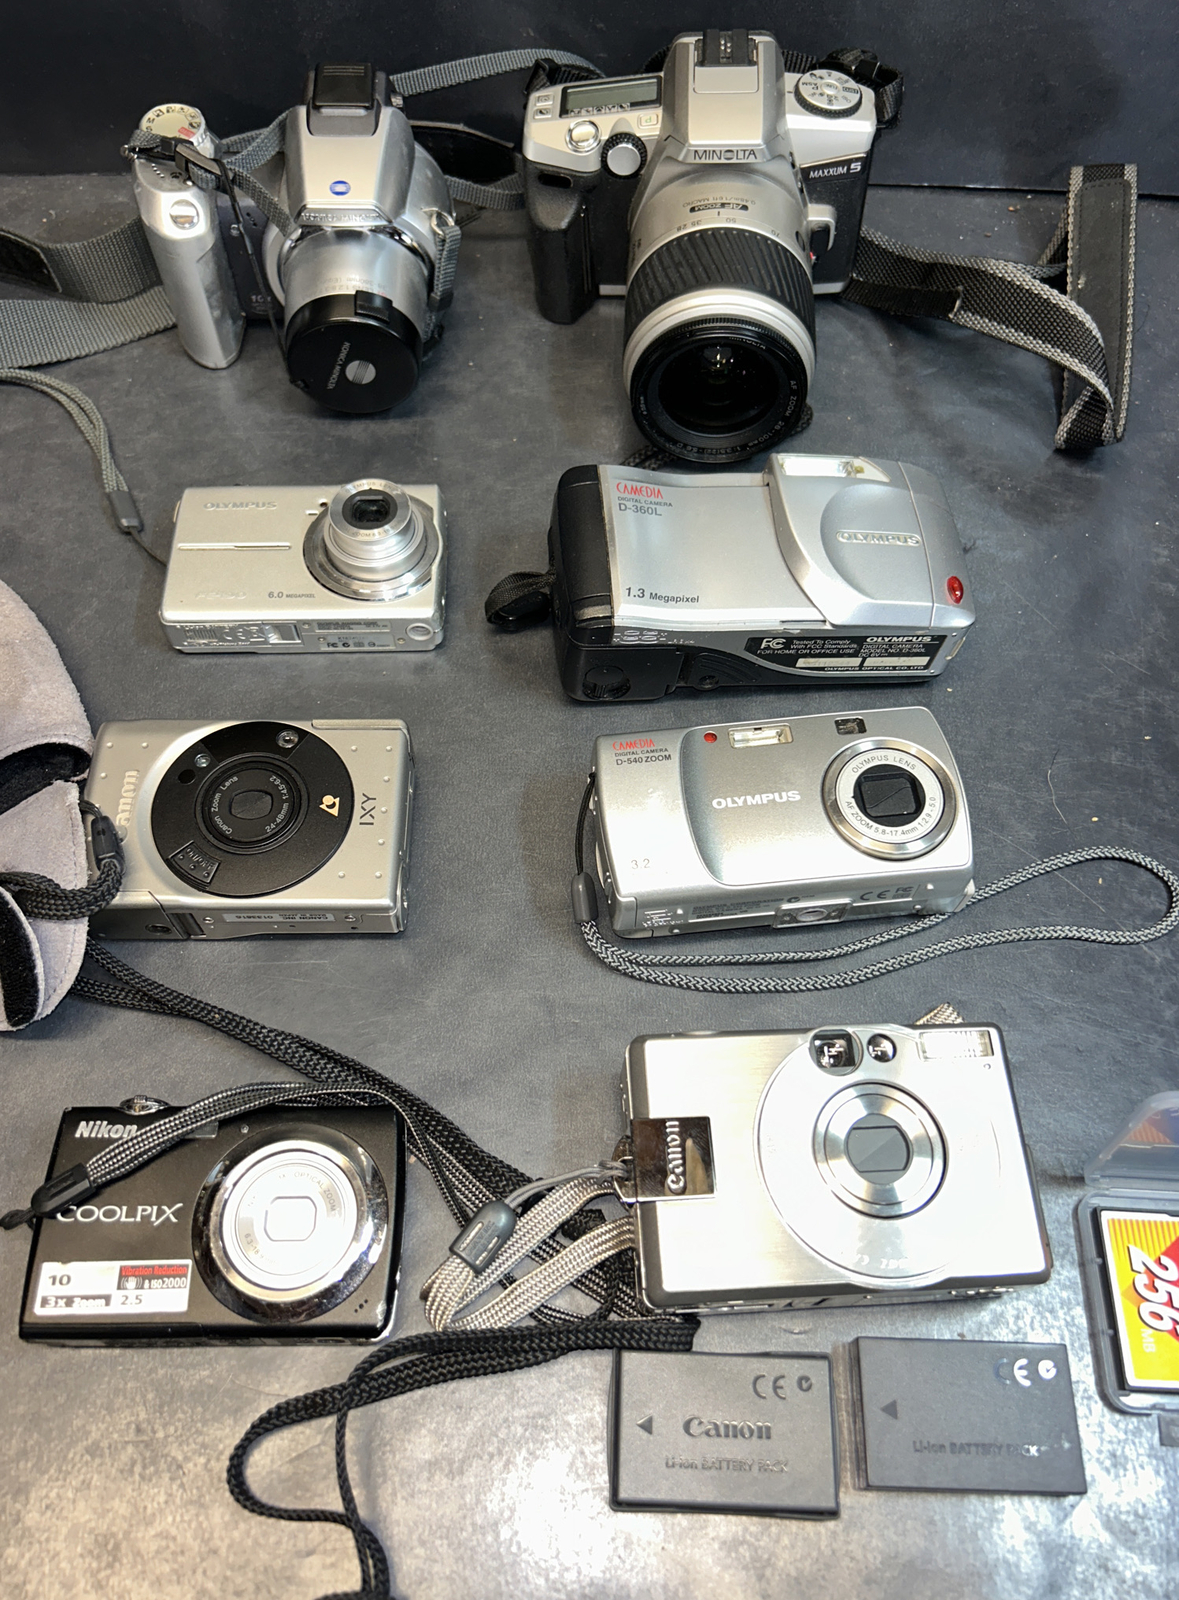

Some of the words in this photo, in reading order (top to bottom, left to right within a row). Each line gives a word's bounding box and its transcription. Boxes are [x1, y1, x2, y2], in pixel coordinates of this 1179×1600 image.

[693, 149, 758, 161] MINOLTA
[809, 166, 847, 178] MAXXUM
[850, 162, 862, 173] 5
[784, 396, 797, 417] ZOOM
[616, 482, 664, 500] CAMEDIA
[203, 502, 278, 510] OLYMPUS
[618, 496, 643, 504] DIGITAL
[618, 502, 662, 516] D-360L
[840, 532, 920, 546] OLYMPUS
[268, 591, 284, 599] 6.0
[626, 587, 645, 598] 1.3
[650, 592, 700, 604] Megapixel
[612, 738, 655, 751] CAMEDIA
[616, 757, 643, 766] D-540
[645, 754, 672, 762] ZOOM
[852, 755, 888, 773] OLYMPUS
[894, 756, 916, 770] LENS
[220, 776, 238, 790] Lens
[211, 792, 222, 812] Zoom
[712, 790, 801, 808] OLYMPUS
[265, 803, 288, 832] 24-48mm
[359, 792, 376, 826] IXY
[214, 816, 232, 834] Canon
[846, 801, 853, 810] AF
[852, 812, 874, 830] ZOOM
[874, 826, 918, 836] 5.8-17.4mm
[631, 858, 650, 869] 3.2
[75, 1121, 138, 1138] Nikon
[666, 1121, 684, 1194] Canon
[294, 1172, 323, 1190] OPTICAL
[324, 1189, 336, 1212] ZOOM
[56, 1203, 184, 1226] COOLPIX
[121, 1266, 152, 1276] Vibration
[154, 1265, 188, 1275] Reduction
[48, 1274, 72, 1286] 10
[1126, 1243, 1179, 1337] 256
[45, 1296, 68, 1308] 3x
[72, 1297, 106, 1308] Zoom
[120, 1294, 143, 1306] 2.5
[1141, 1328, 1156, 1353] MB
[752, 1374, 786, 1400] CE
[682, 1415, 772, 1440] Canon
[950, 1442, 1004, 1456] BATTERY
[1006, 1444, 1040, 1457] PACK
[701, 1457, 754, 1472] BATTERY
[758, 1459, 788, 1473] PACK
